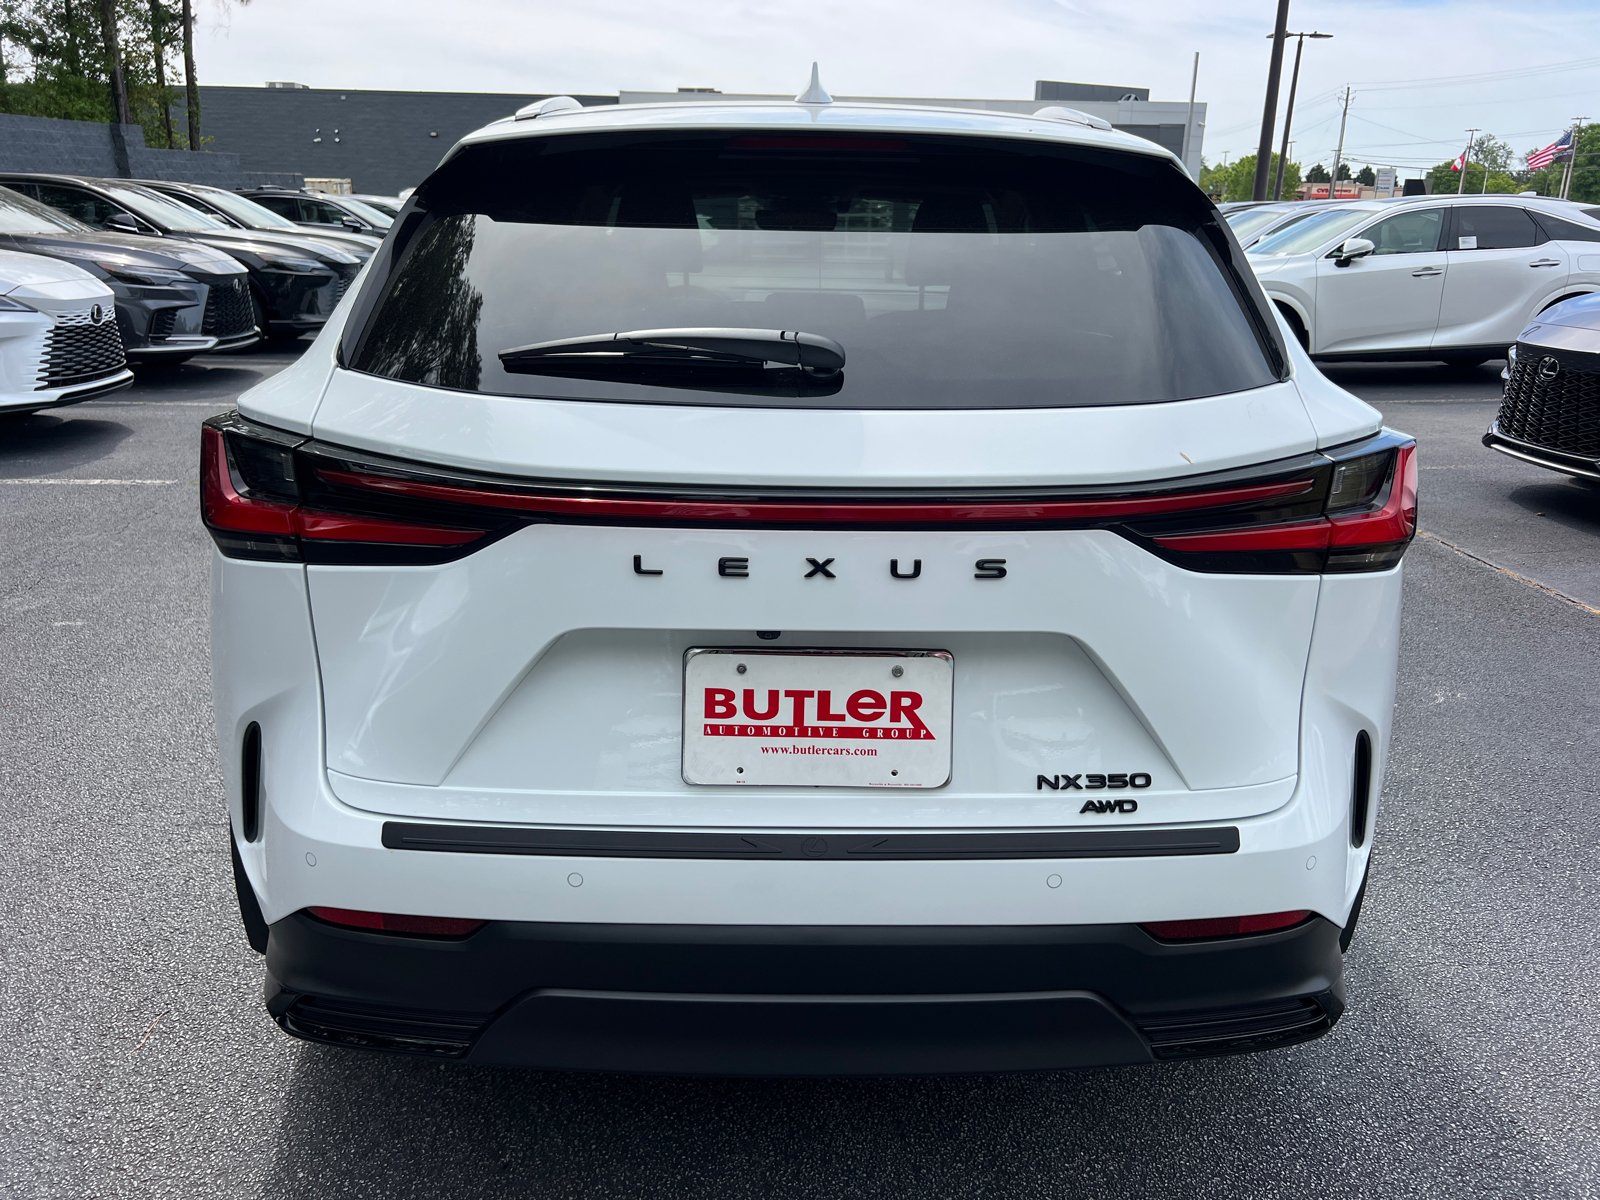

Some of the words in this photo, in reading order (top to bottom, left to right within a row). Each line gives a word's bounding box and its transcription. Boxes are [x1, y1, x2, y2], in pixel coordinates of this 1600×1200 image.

[633, 554, 1008, 579] LEXUS
[705, 725, 839, 737] AUTOMOTIVE
[862, 727, 928, 739] GROUP
[760, 744, 878, 757] www.butlercars.com
[1036, 772, 1152, 790] NX350
[1079, 799, 1138, 814] AWD
